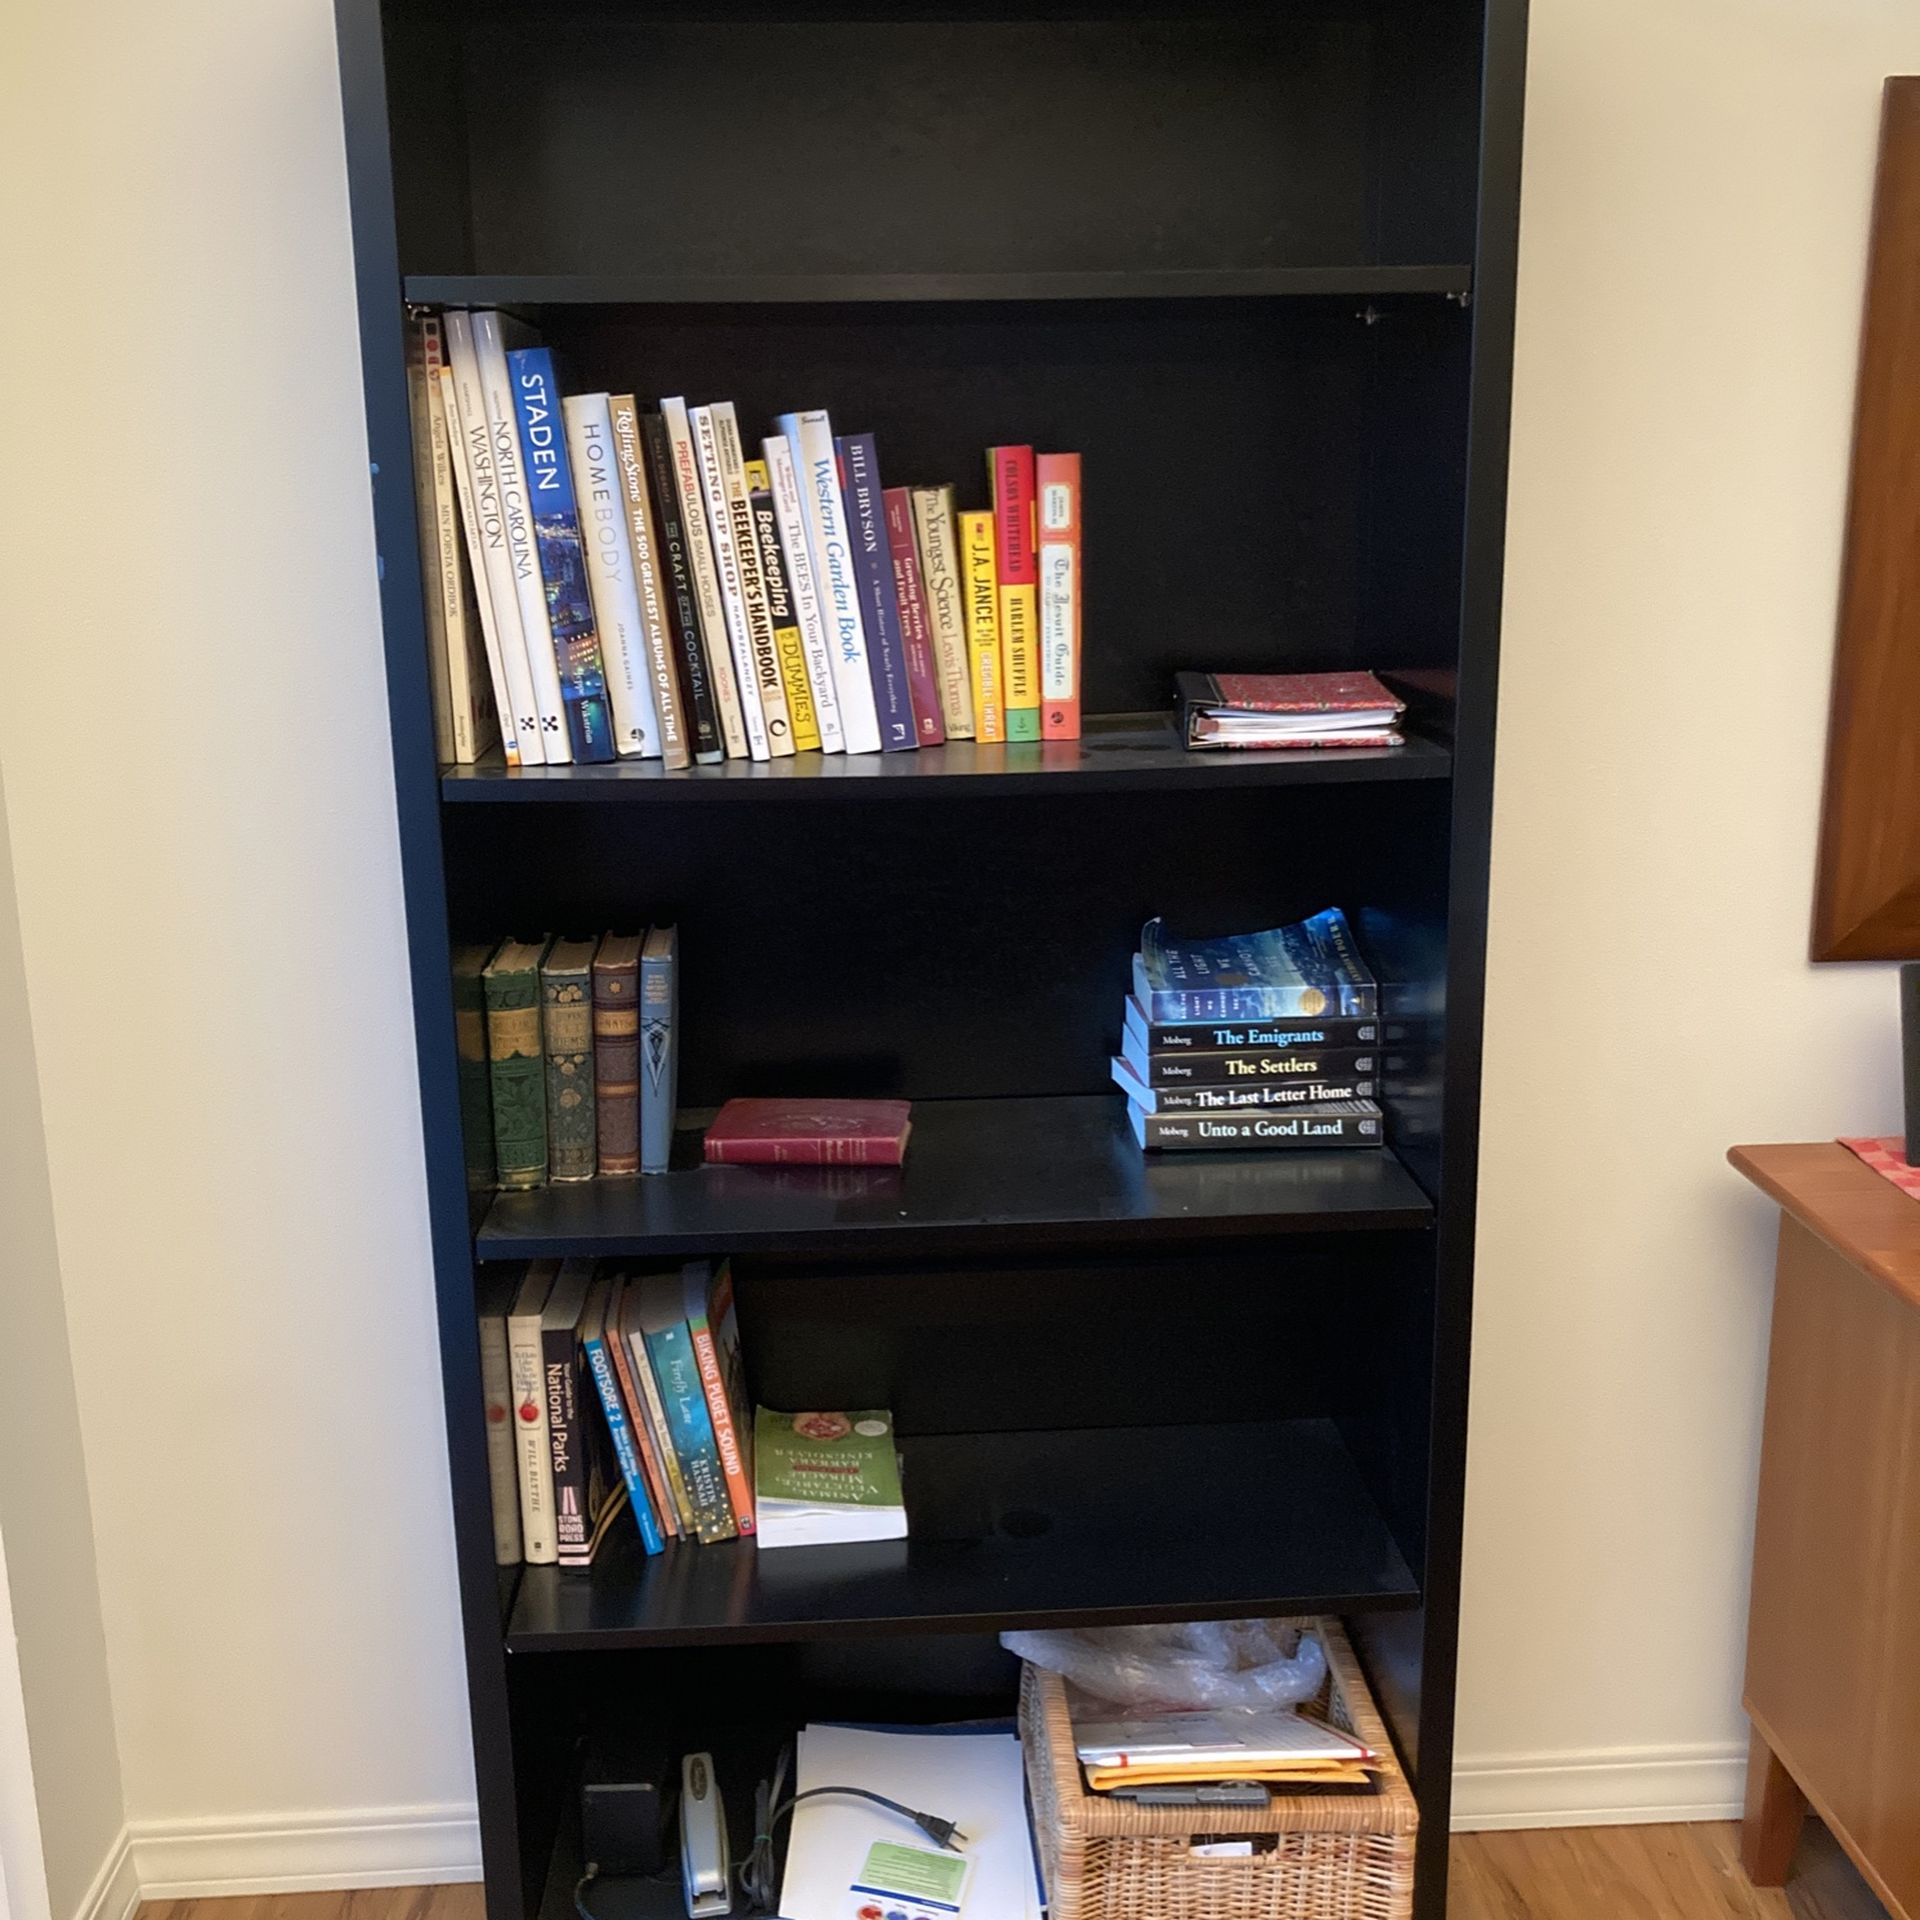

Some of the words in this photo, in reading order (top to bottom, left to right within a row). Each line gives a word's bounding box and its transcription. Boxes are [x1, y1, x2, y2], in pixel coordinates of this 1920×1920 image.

[432, 414, 443, 448] Angela
[493, 419, 517, 485] NORTH
[520, 372, 559, 491] STADEN
[612, 407, 639, 464] Rolling
[436, 452, 446, 485] Wilkes
[623, 458, 644, 502] Stone
[698, 414, 722, 503] SETTING
[850, 444, 866, 482] BILL
[1005, 460, 1018, 499] COLSON
[468, 425, 504, 549] WASHINGTON
[581, 423, 623, 584] HOMEBODY
[675, 440, 702, 536] PREFABULOUS
[730, 480, 741, 497] THE
[812, 458, 840, 536] Western
[503, 489, 532, 578] CAROLINA
[631, 508, 645, 532] THE
[713, 510, 728, 535] UP
[787, 521, 803, 549] The
[856, 487, 876, 552] BRYSON
[1006, 505, 1021, 571] WHITEHEAD
[635, 535, 650, 560] 500
[693, 539, 707, 573] SMALL
[730, 498, 763, 600] BEEKEEPER'S
[755, 508, 791, 618] Beekeeping
[923, 513, 949, 574] Youngest
[971, 543, 989, 571] J.A.
[719, 541, 738, 597] SHOP
[793, 551, 810, 592] BEES
[825, 539, 852, 612] Garden
[893, 559, 904, 579] and
[1054, 558, 1068, 587] The
[639, 562, 659, 621] GREATEST
[699, 574, 715, 617] HOUSES
[800, 594, 814, 610] In
[896, 581, 908, 606] Fruit
[902, 557, 917, 600] Growing
[910, 602, 923, 640] Berries
[929, 575, 957, 630] Science
[973, 575, 992, 623] JANCE
[668, 541, 687, 591] CRAFT
[683, 630, 704, 700] COCKTAIL
[804, 614, 820, 645] Your
[875, 608, 887, 637] History
[900, 608, 912, 636] Trees
[1010, 598, 1024, 640] HARLEM
[1053, 593, 1068, 636] Jesuit
[616, 621, 628, 656] JOANNA
[648, 624, 666, 671] ALBUMS
[748, 603, 778, 688] HANDBOOK
[836, 614, 861, 664] Book
[942, 632, 960, 668] Lewis
[656, 673, 669, 690] OF
[781, 641, 813, 723] DUMMIES
[807, 648, 832, 708] Backyard
[979, 651, 993, 697] CREDIBLE
[1011, 647, 1026, 695] SHUFFLE
[1054, 642, 1068, 685] Guide
[659, 691, 673, 713] ALL
[946, 669, 965, 715] Thomas
[663, 716, 677, 742] TIME
[982, 701, 995, 737] THREAT
[1162, 1036, 1192, 1046] Moberg
[1213, 1029, 1244, 1045] The
[1248, 1028, 1325, 1047] Emigrants
[1162, 1067, 1192, 1077] Moberg
[1225, 1059, 1256, 1075] The
[1260, 1058, 1317, 1074] Settlers
[1164, 1096, 1192, 1106] Moberg
[1195, 1091, 1225, 1107] The
[1228, 1089, 1259, 1105] Last
[1262, 1087, 1306, 1104] Letter
[1309, 1085, 1353, 1101] Home
[1159, 1126, 1189, 1138] Moberg
[1198, 1121, 1237, 1137] Unto
[1241, 1125, 1251, 1136] a
[1254, 1120, 1298, 1136] Good
[1302, 1119, 1343, 1135] Land
[546, 1363, 566, 1429] National
[588, 1347, 620, 1412] FOOTSORE
[608, 1412, 622, 1422] 2
[667, 1358, 688, 1394] Firefly
[677, 1395, 695, 1425] Lane
[695, 1334, 717, 1379] BIKING
[707, 1382, 727, 1426] PUGET
[717, 1428, 740, 1476] SOUND
[526, 1439, 536, 1467] WILL
[552, 1432, 569, 1471] Parks
[774, 1449, 873, 1460] KINGSOLVER
[789, 1457, 859, 1467] BARBARA
[528, 1470, 539, 1512] BLYTHE
[690, 1460, 709, 1507] HANNAH
[698, 1458, 716, 1503] KRISTIN
